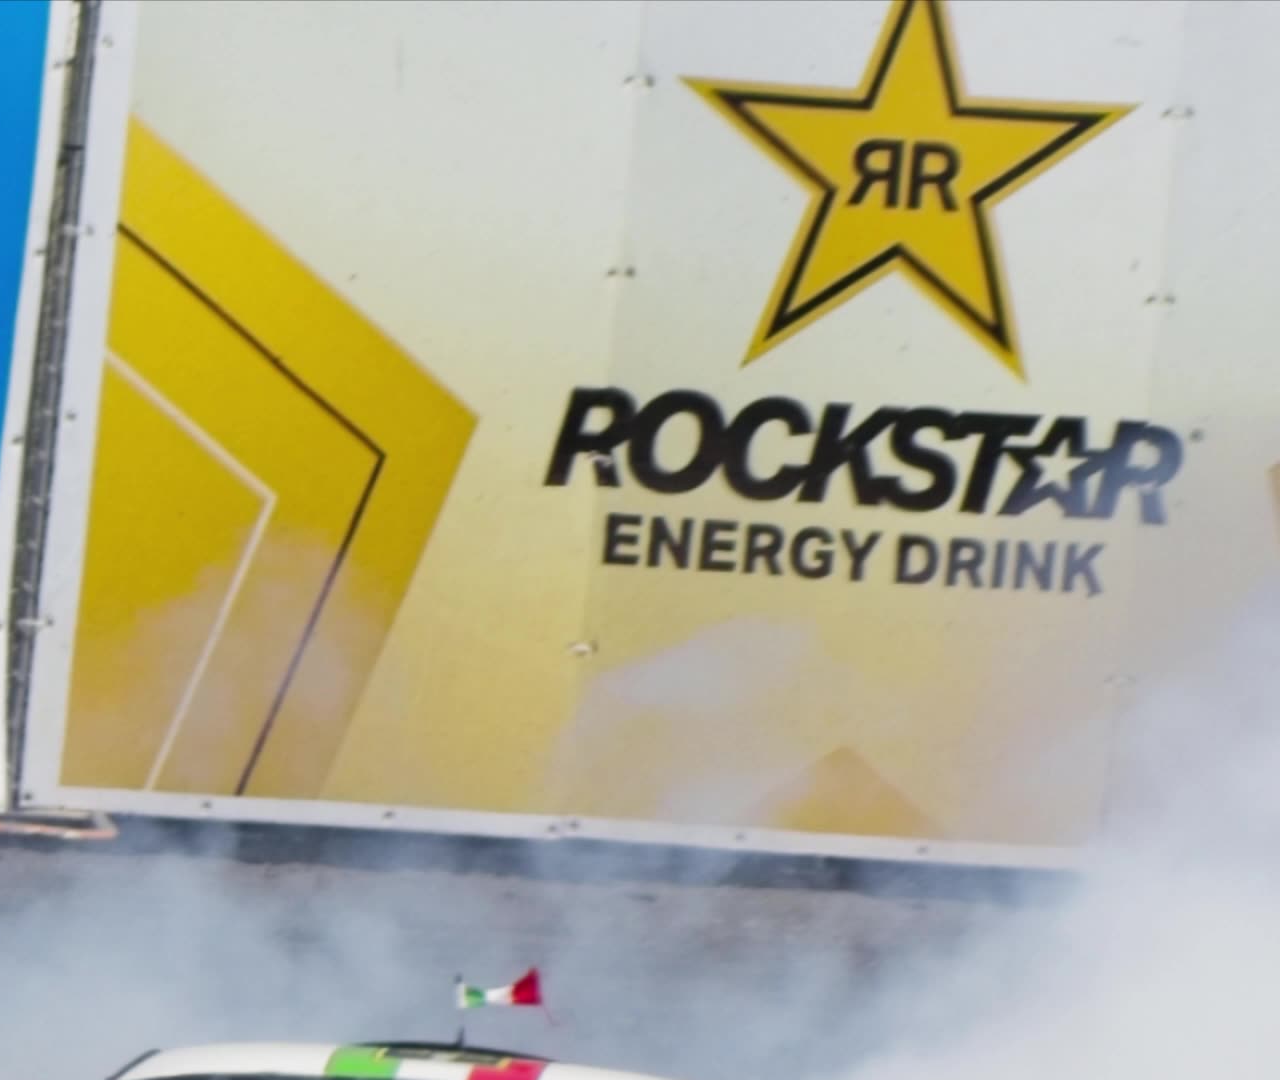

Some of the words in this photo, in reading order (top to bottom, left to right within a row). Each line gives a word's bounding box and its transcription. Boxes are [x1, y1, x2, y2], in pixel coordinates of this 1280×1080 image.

[543, 386, 1185, 525] ROCKSTAR
[601, 512, 882, 582] ENERGY
[895, 535, 1106, 598] DRINK
